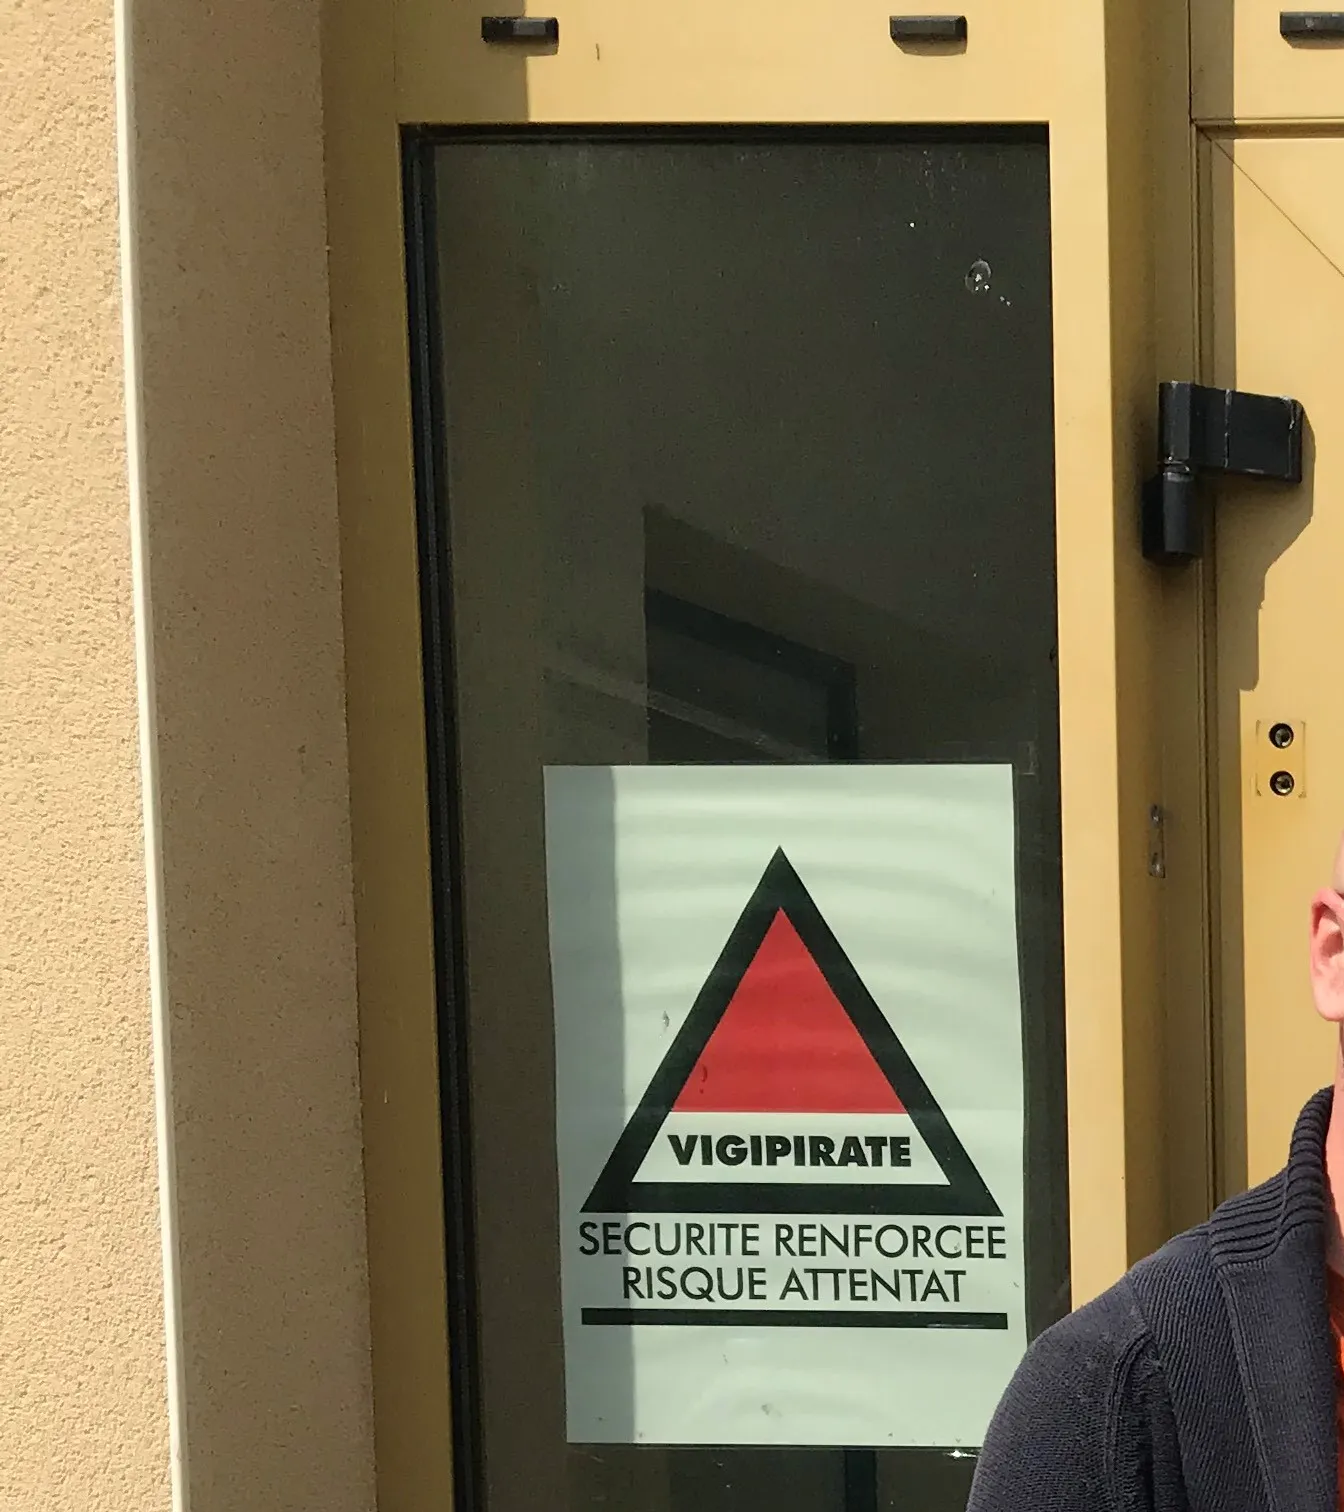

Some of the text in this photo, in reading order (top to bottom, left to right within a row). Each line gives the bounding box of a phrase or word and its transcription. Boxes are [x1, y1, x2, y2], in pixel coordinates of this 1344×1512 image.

[668, 1134, 912, 1168] VIGIPIRATE
[578, 1222, 1006, 1261] SECURITE RENFORCEE
[622, 1266, 967, 1304] RISQUE ATTENTAT
